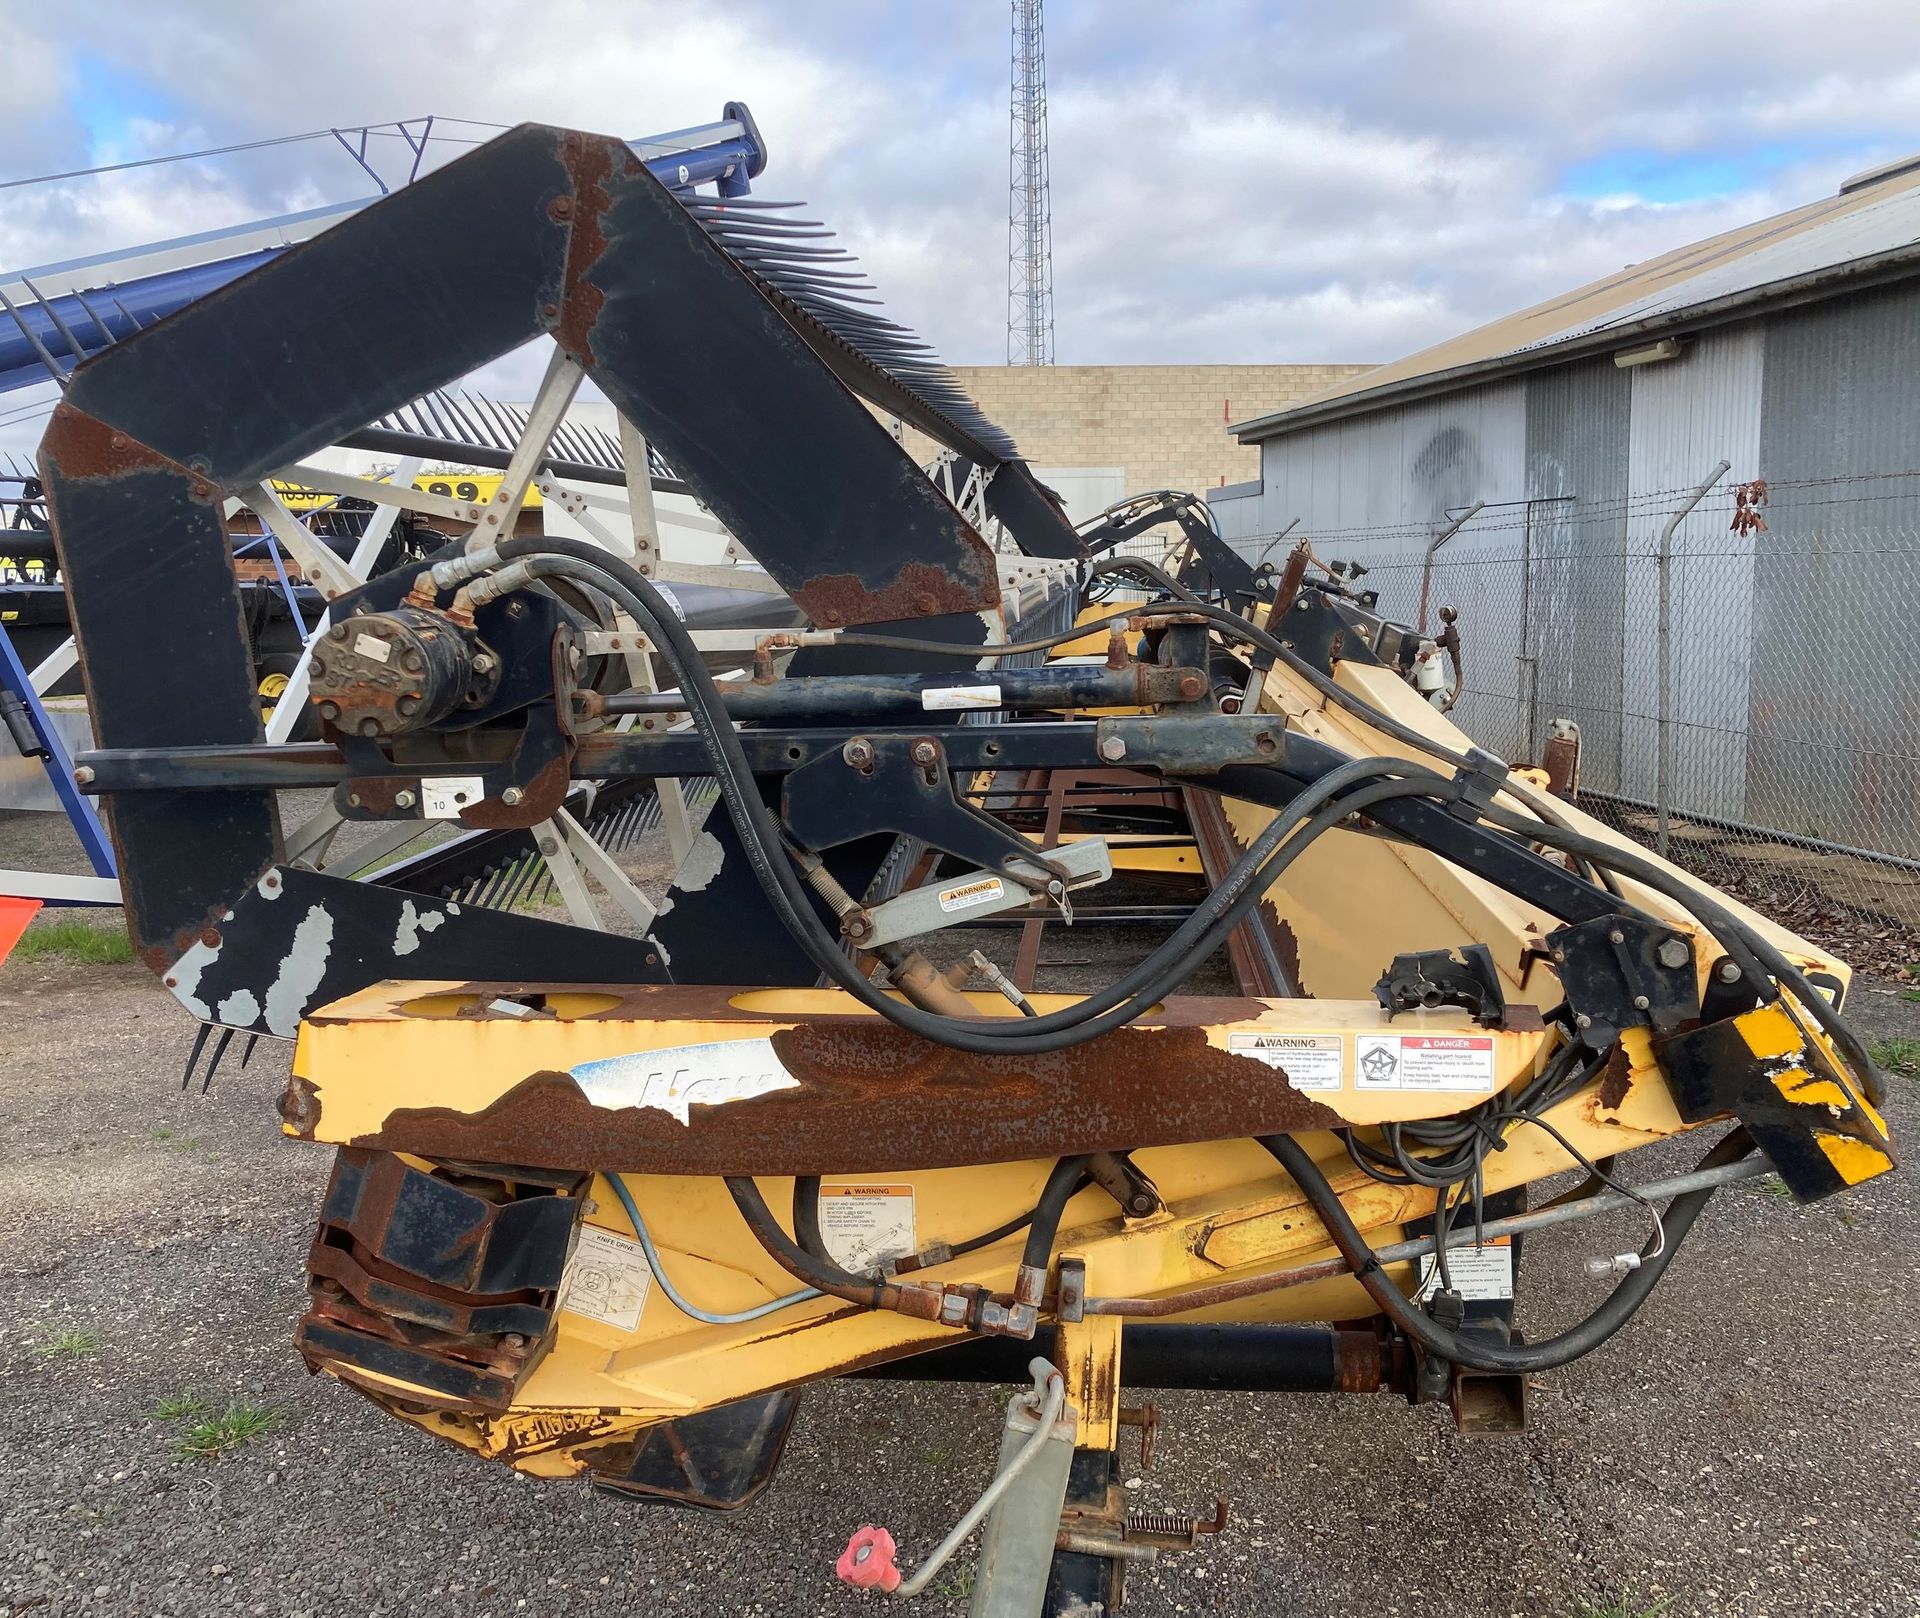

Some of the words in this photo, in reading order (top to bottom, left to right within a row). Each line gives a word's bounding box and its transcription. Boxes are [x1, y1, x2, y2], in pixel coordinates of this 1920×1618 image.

[433, 801, 445, 810] 10
[956, 883, 991, 897] WARNING
[1266, 1039, 1316, 1048] WARNING
[1433, 1040, 1470, 1048] DANGER
[596, 1235, 616, 1246] KNIFE
[616, 1241, 634, 1252] DRIVE
